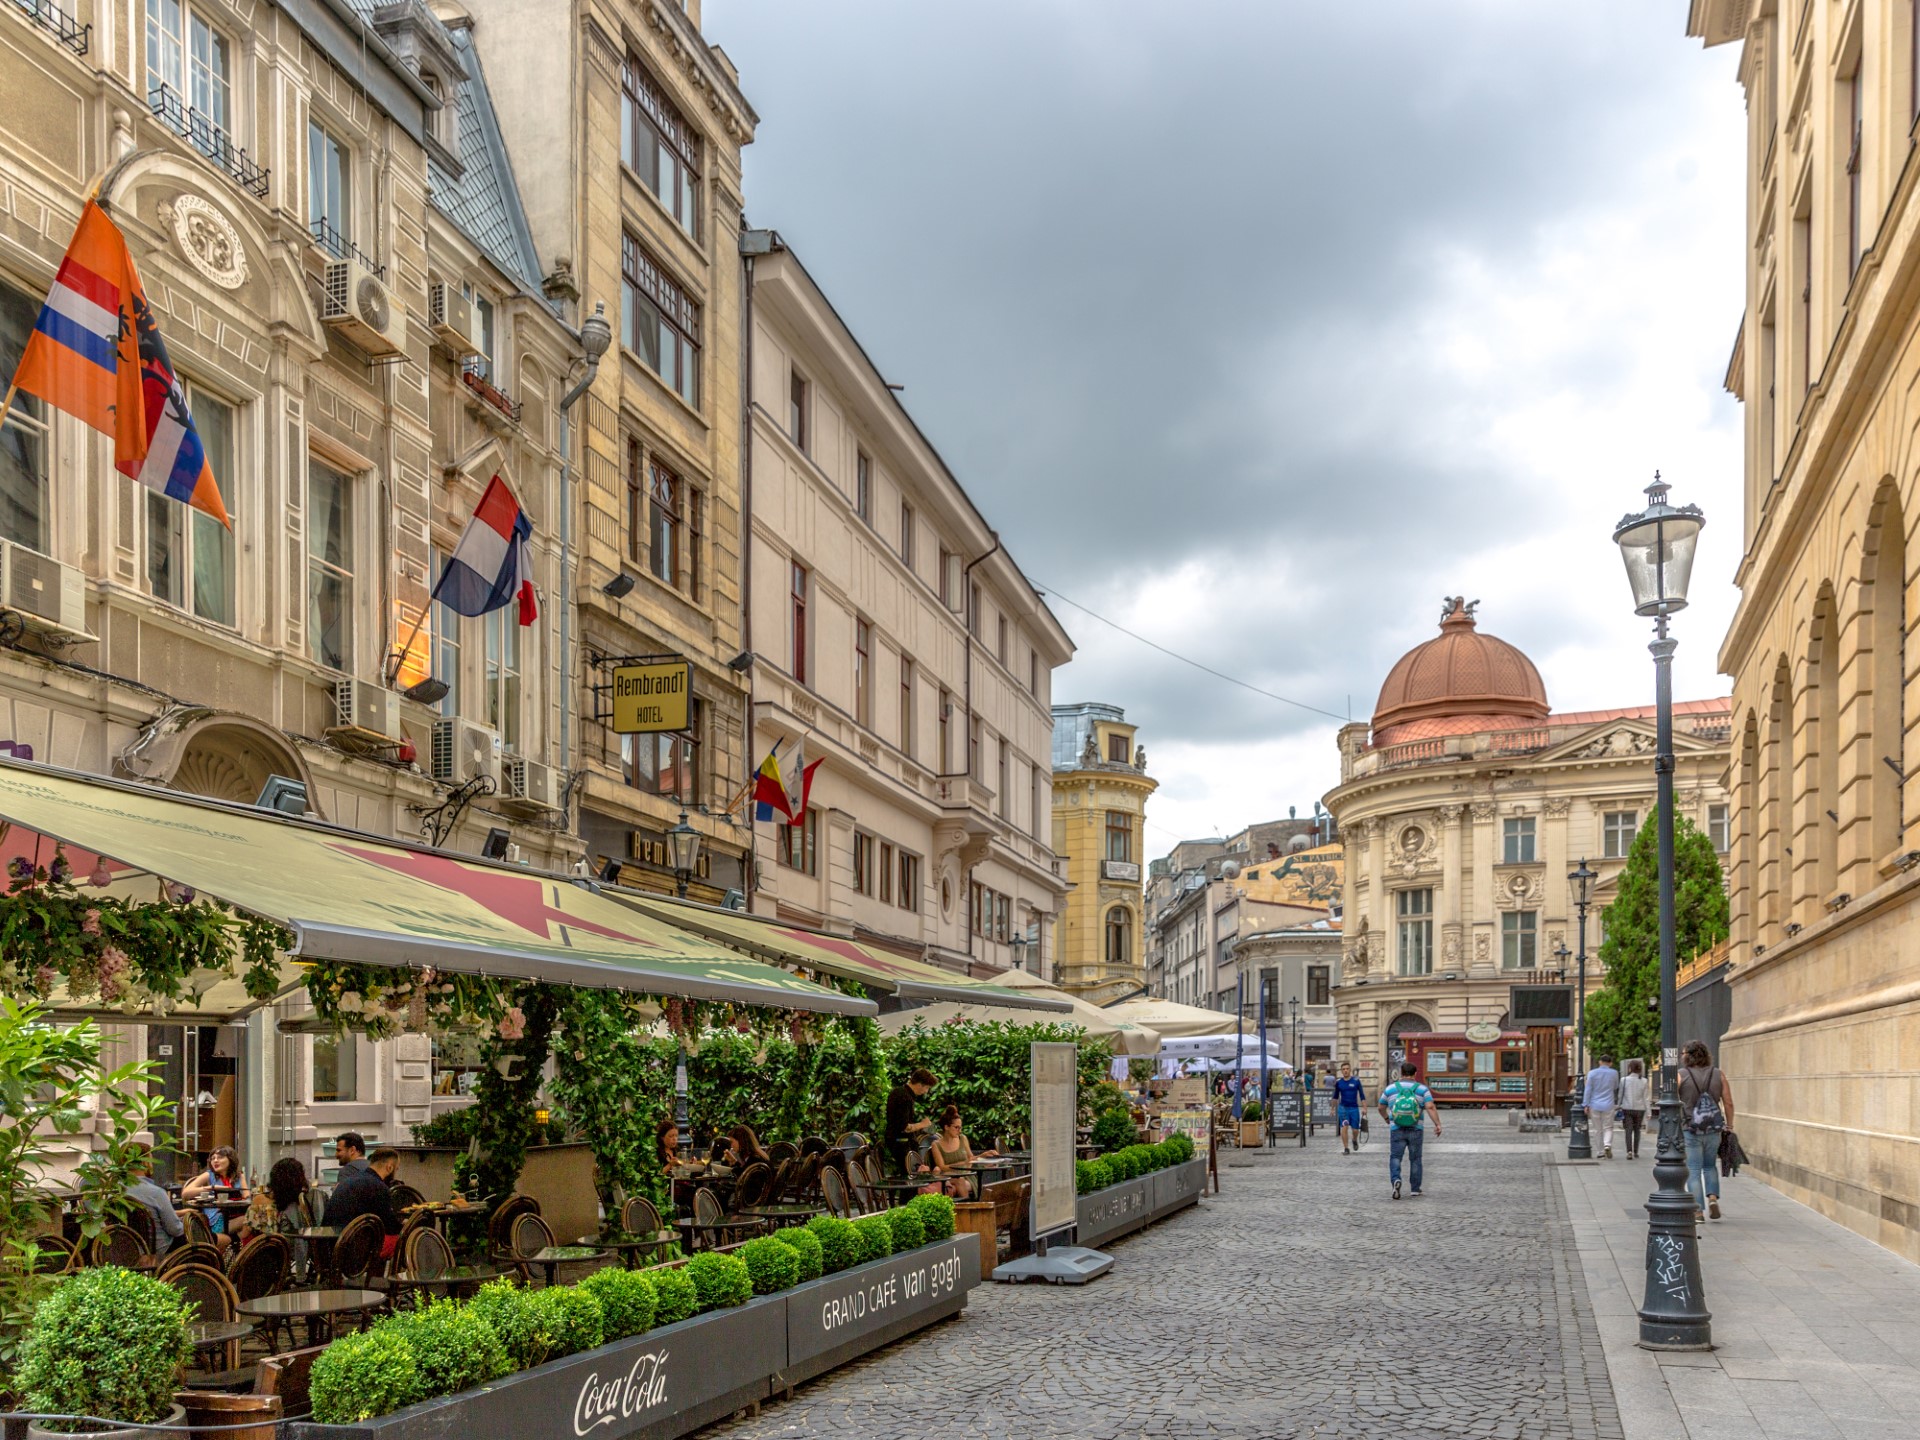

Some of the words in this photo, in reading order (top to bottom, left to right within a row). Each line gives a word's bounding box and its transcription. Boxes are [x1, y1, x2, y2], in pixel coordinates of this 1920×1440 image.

[637, 706, 663, 724] HOTEL
[822, 1289, 866, 1331] GRAND
[868, 1273, 897, 1312] CAFÉ
[903, 1268, 926, 1299] van
[930, 1247, 961, 1298] gogh
